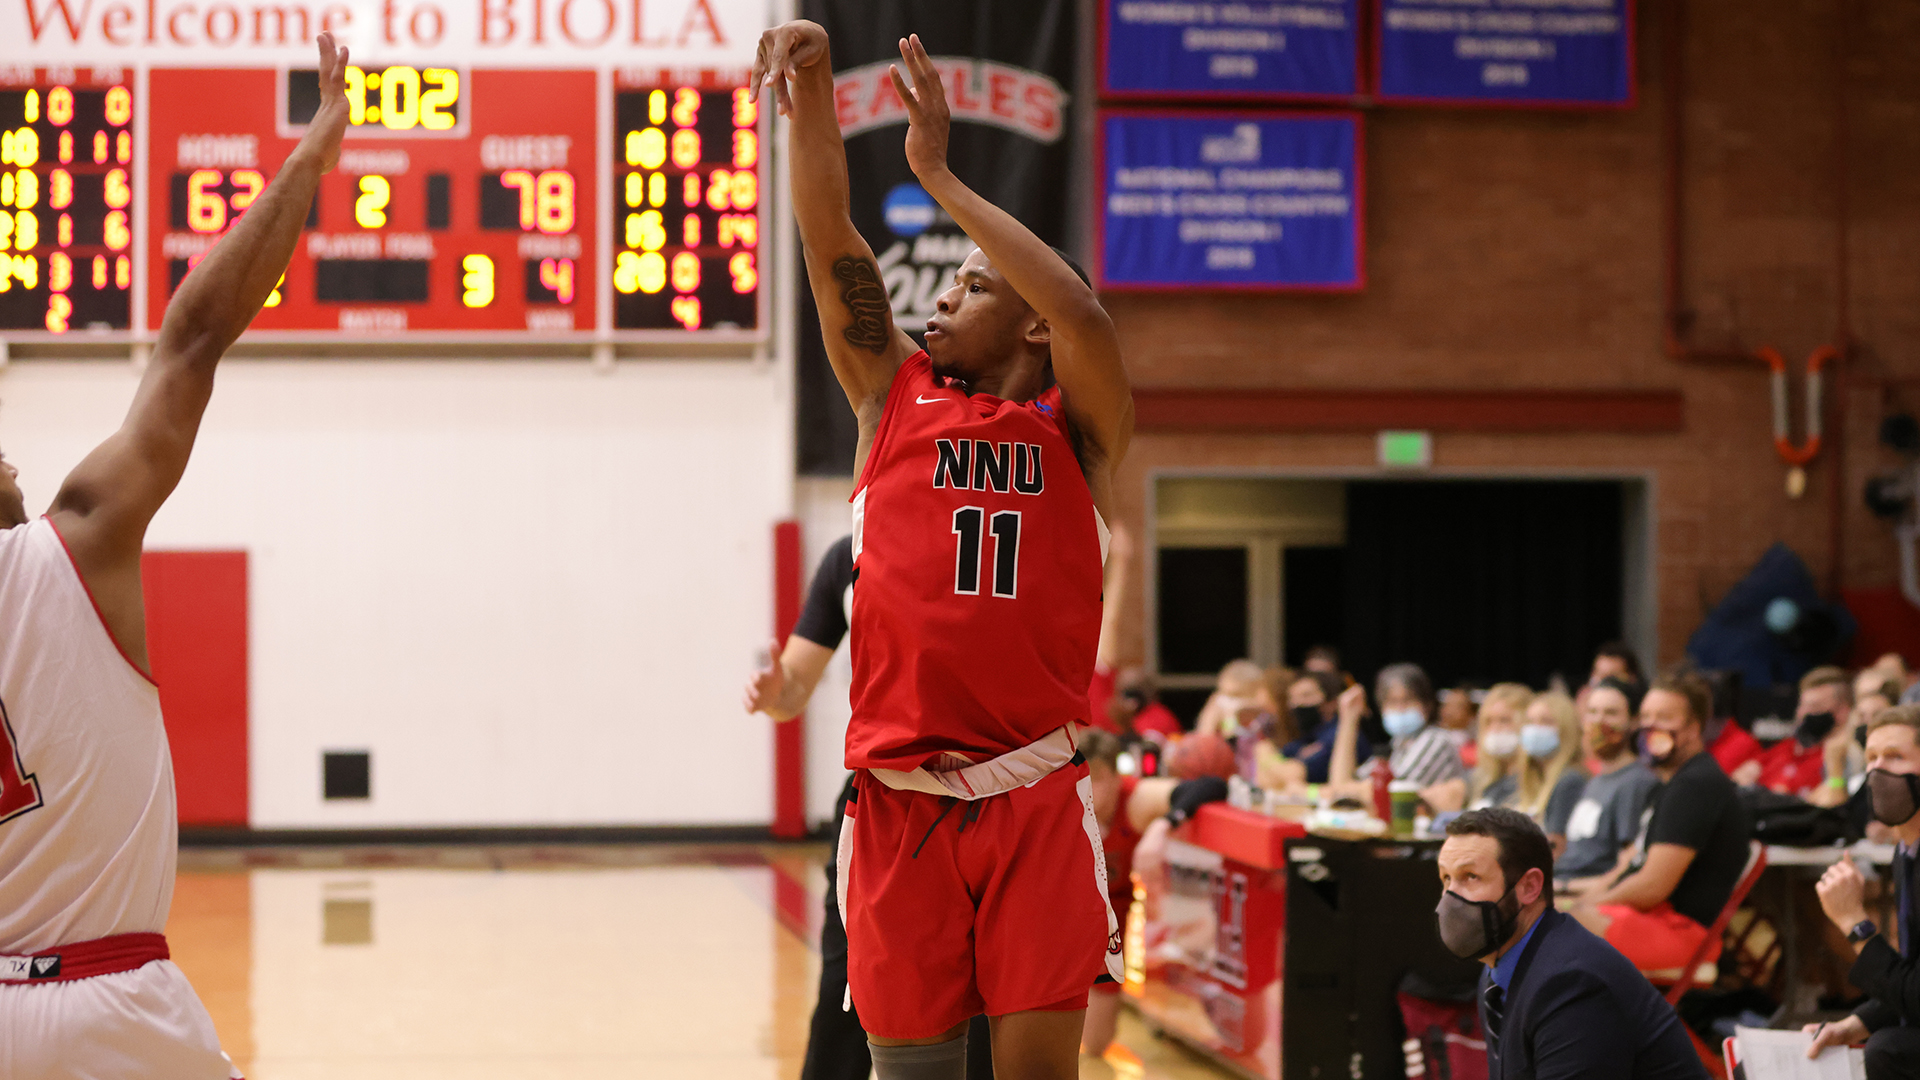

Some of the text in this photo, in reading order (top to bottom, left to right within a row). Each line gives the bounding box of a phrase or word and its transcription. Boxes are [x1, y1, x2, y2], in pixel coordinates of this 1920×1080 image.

[20, 0, 732, 48] Welcome to BIOLA
[24, 85, 132, 126] 1 0 0
[649, 86, 759, 128] 1 2 3
[834, 60, 1063, 138] EALES
[58, 130, 74, 164] 1
[93, 130, 132, 164] 11
[177, 134, 259, 168] HOME
[480, 136, 572, 169] GUEST
[671, 127, 701, 169] 0
[732, 127, 759, 169] 3
[49, 168, 74, 209] 3
[103, 168, 132, 209] 6
[355, 174, 391, 229] 2
[501, 169, 575, 234] 78
[625, 171, 667, 207] 11
[683, 172, 701, 207] 1
[57, 213, 73, 247] 1
[103, 210, 132, 251] 6
[683, 212, 701, 248] 1
[49, 251, 73, 292] 3
[91, 254, 131, 289] 11
[462, 254, 494, 308] 3
[540, 257, 574, 304] 4
[671, 251, 701, 293] 0
[728, 251, 759, 293] 5
[45, 293, 72, 334] 2
[671, 296, 701, 331] 4
[933, 438, 1044, 496] NNU
[952, 505, 1022, 600] 11
